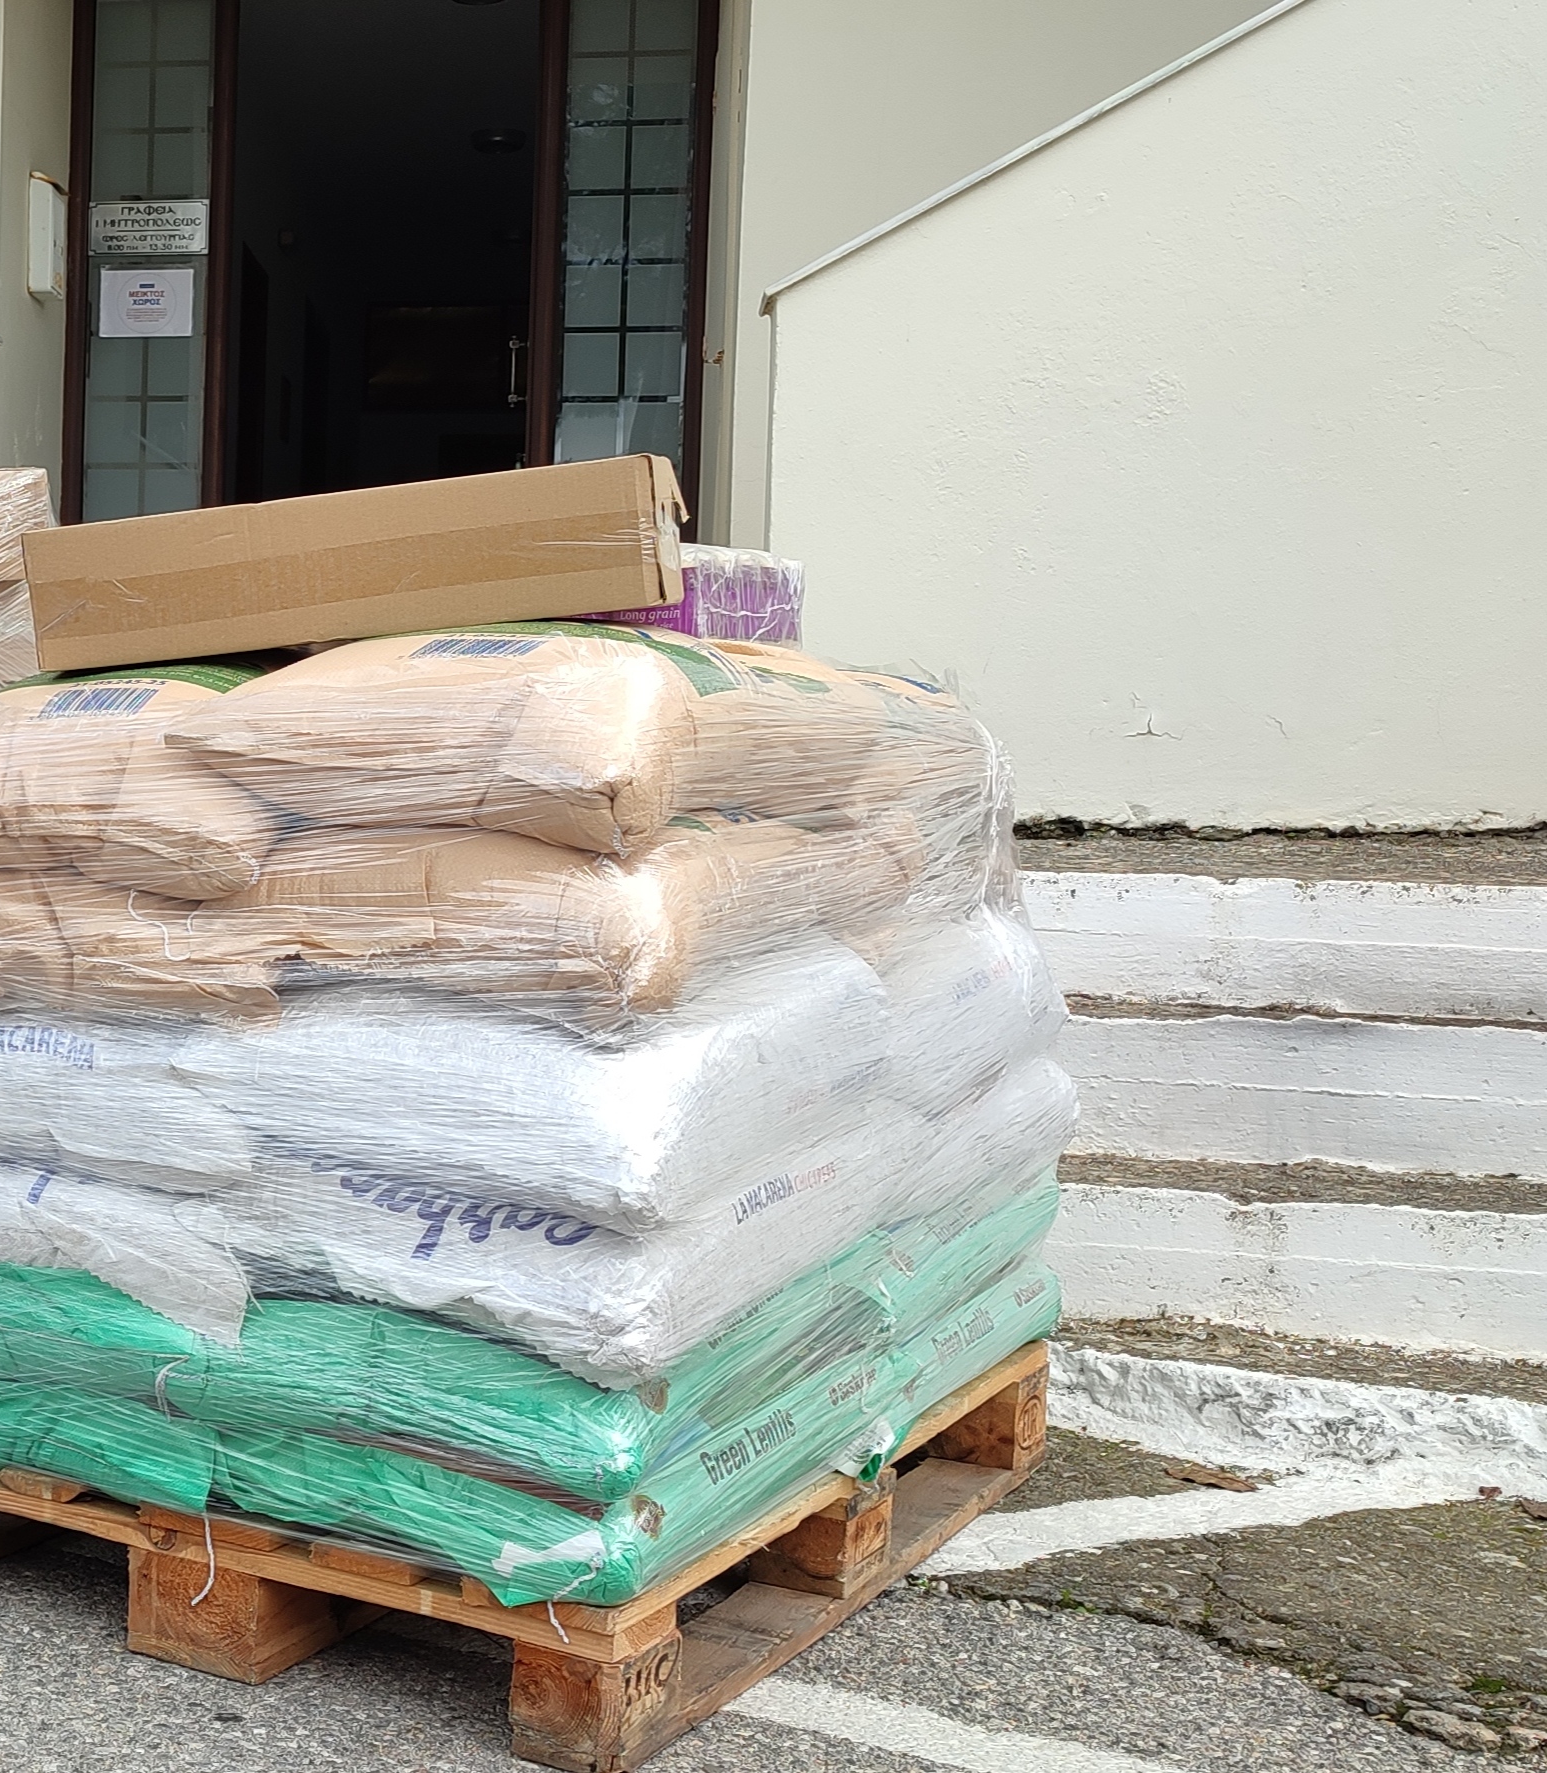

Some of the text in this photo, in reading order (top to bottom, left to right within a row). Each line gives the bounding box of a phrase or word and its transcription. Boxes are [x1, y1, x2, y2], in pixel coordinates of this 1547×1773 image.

[121, 205, 176, 216] ΓΡΑΦΕΙΑ
[620, 607, 681, 623] Long grain
[744, 1173, 795, 1216] MACARENA
[700, 1438, 751, 1486] Green
[743, 1408, 797, 1458] Lentils
